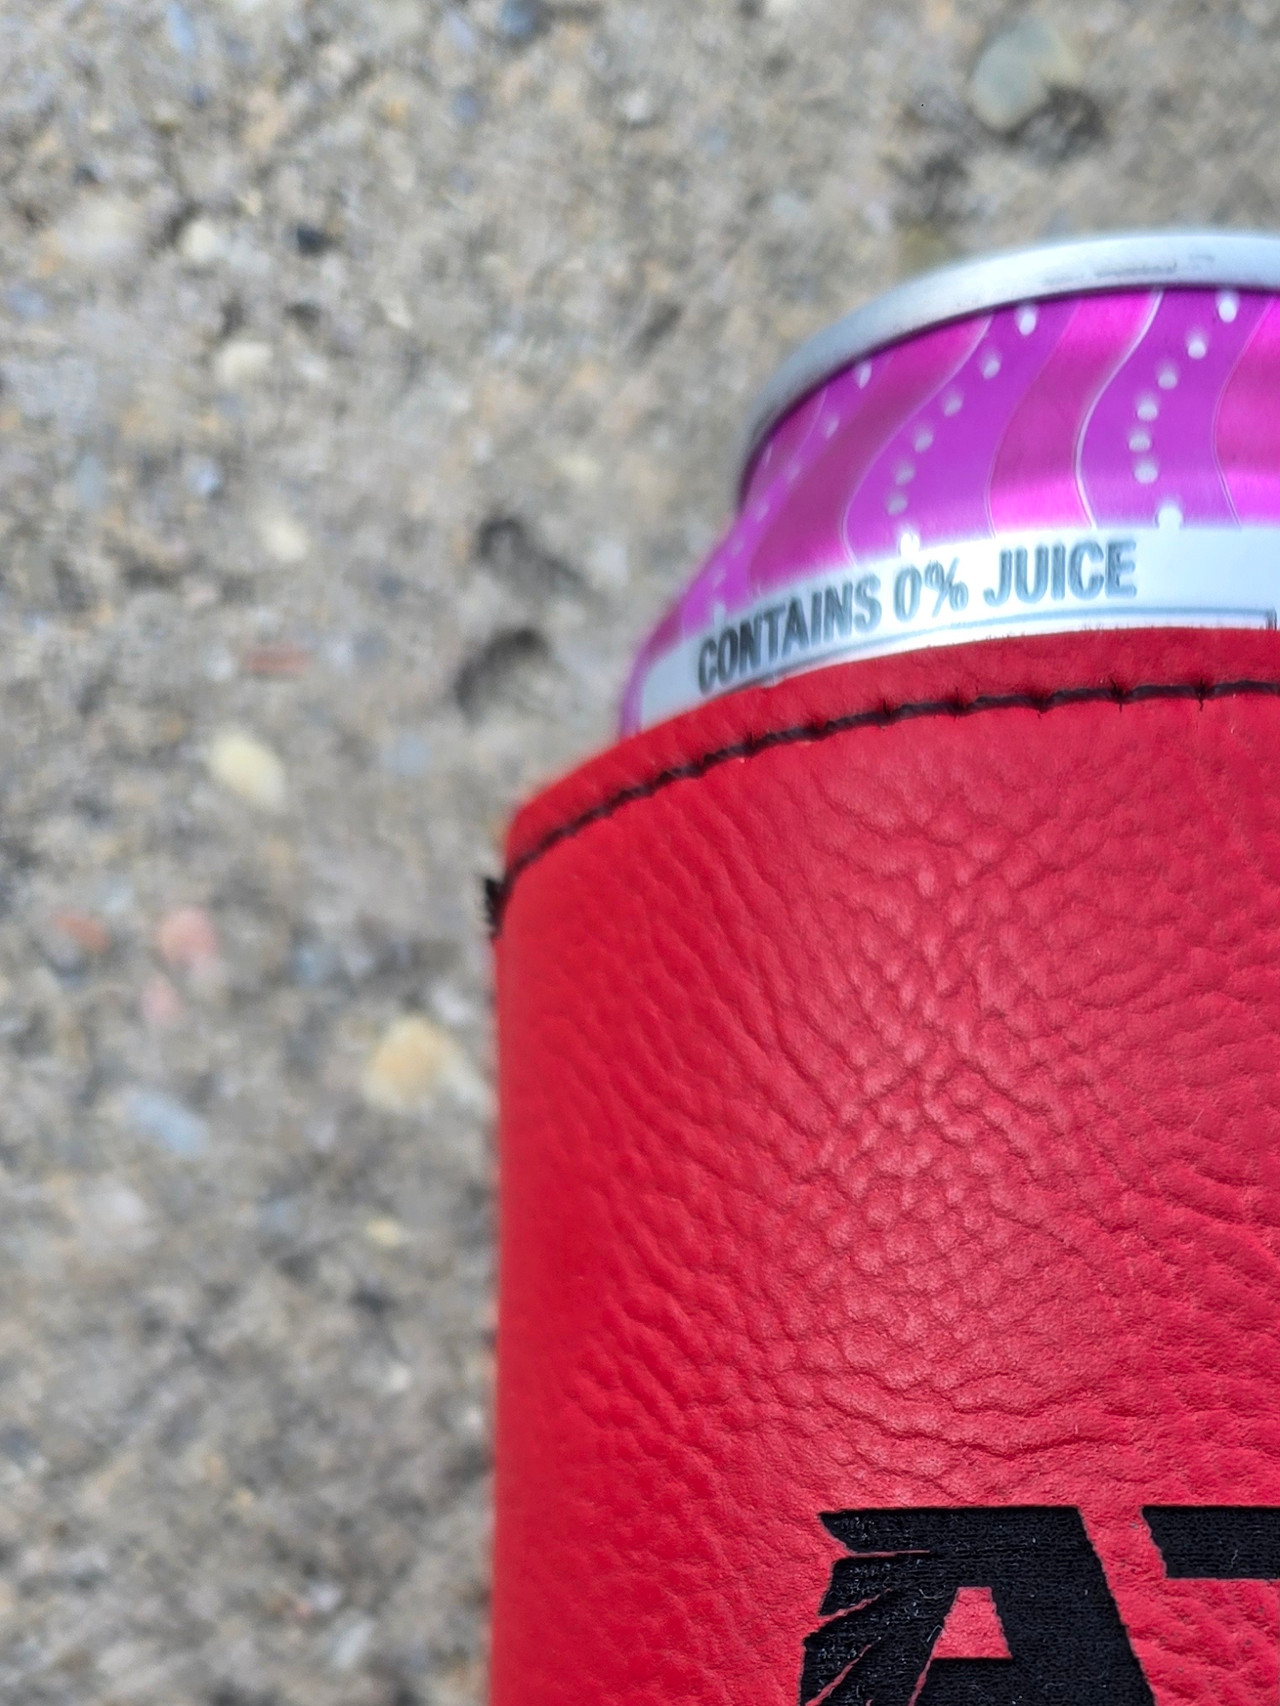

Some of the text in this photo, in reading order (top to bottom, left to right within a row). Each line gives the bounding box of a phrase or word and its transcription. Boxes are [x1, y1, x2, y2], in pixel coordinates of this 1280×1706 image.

[698, 539, 1138, 695] CONTAINS 0% JUICE
